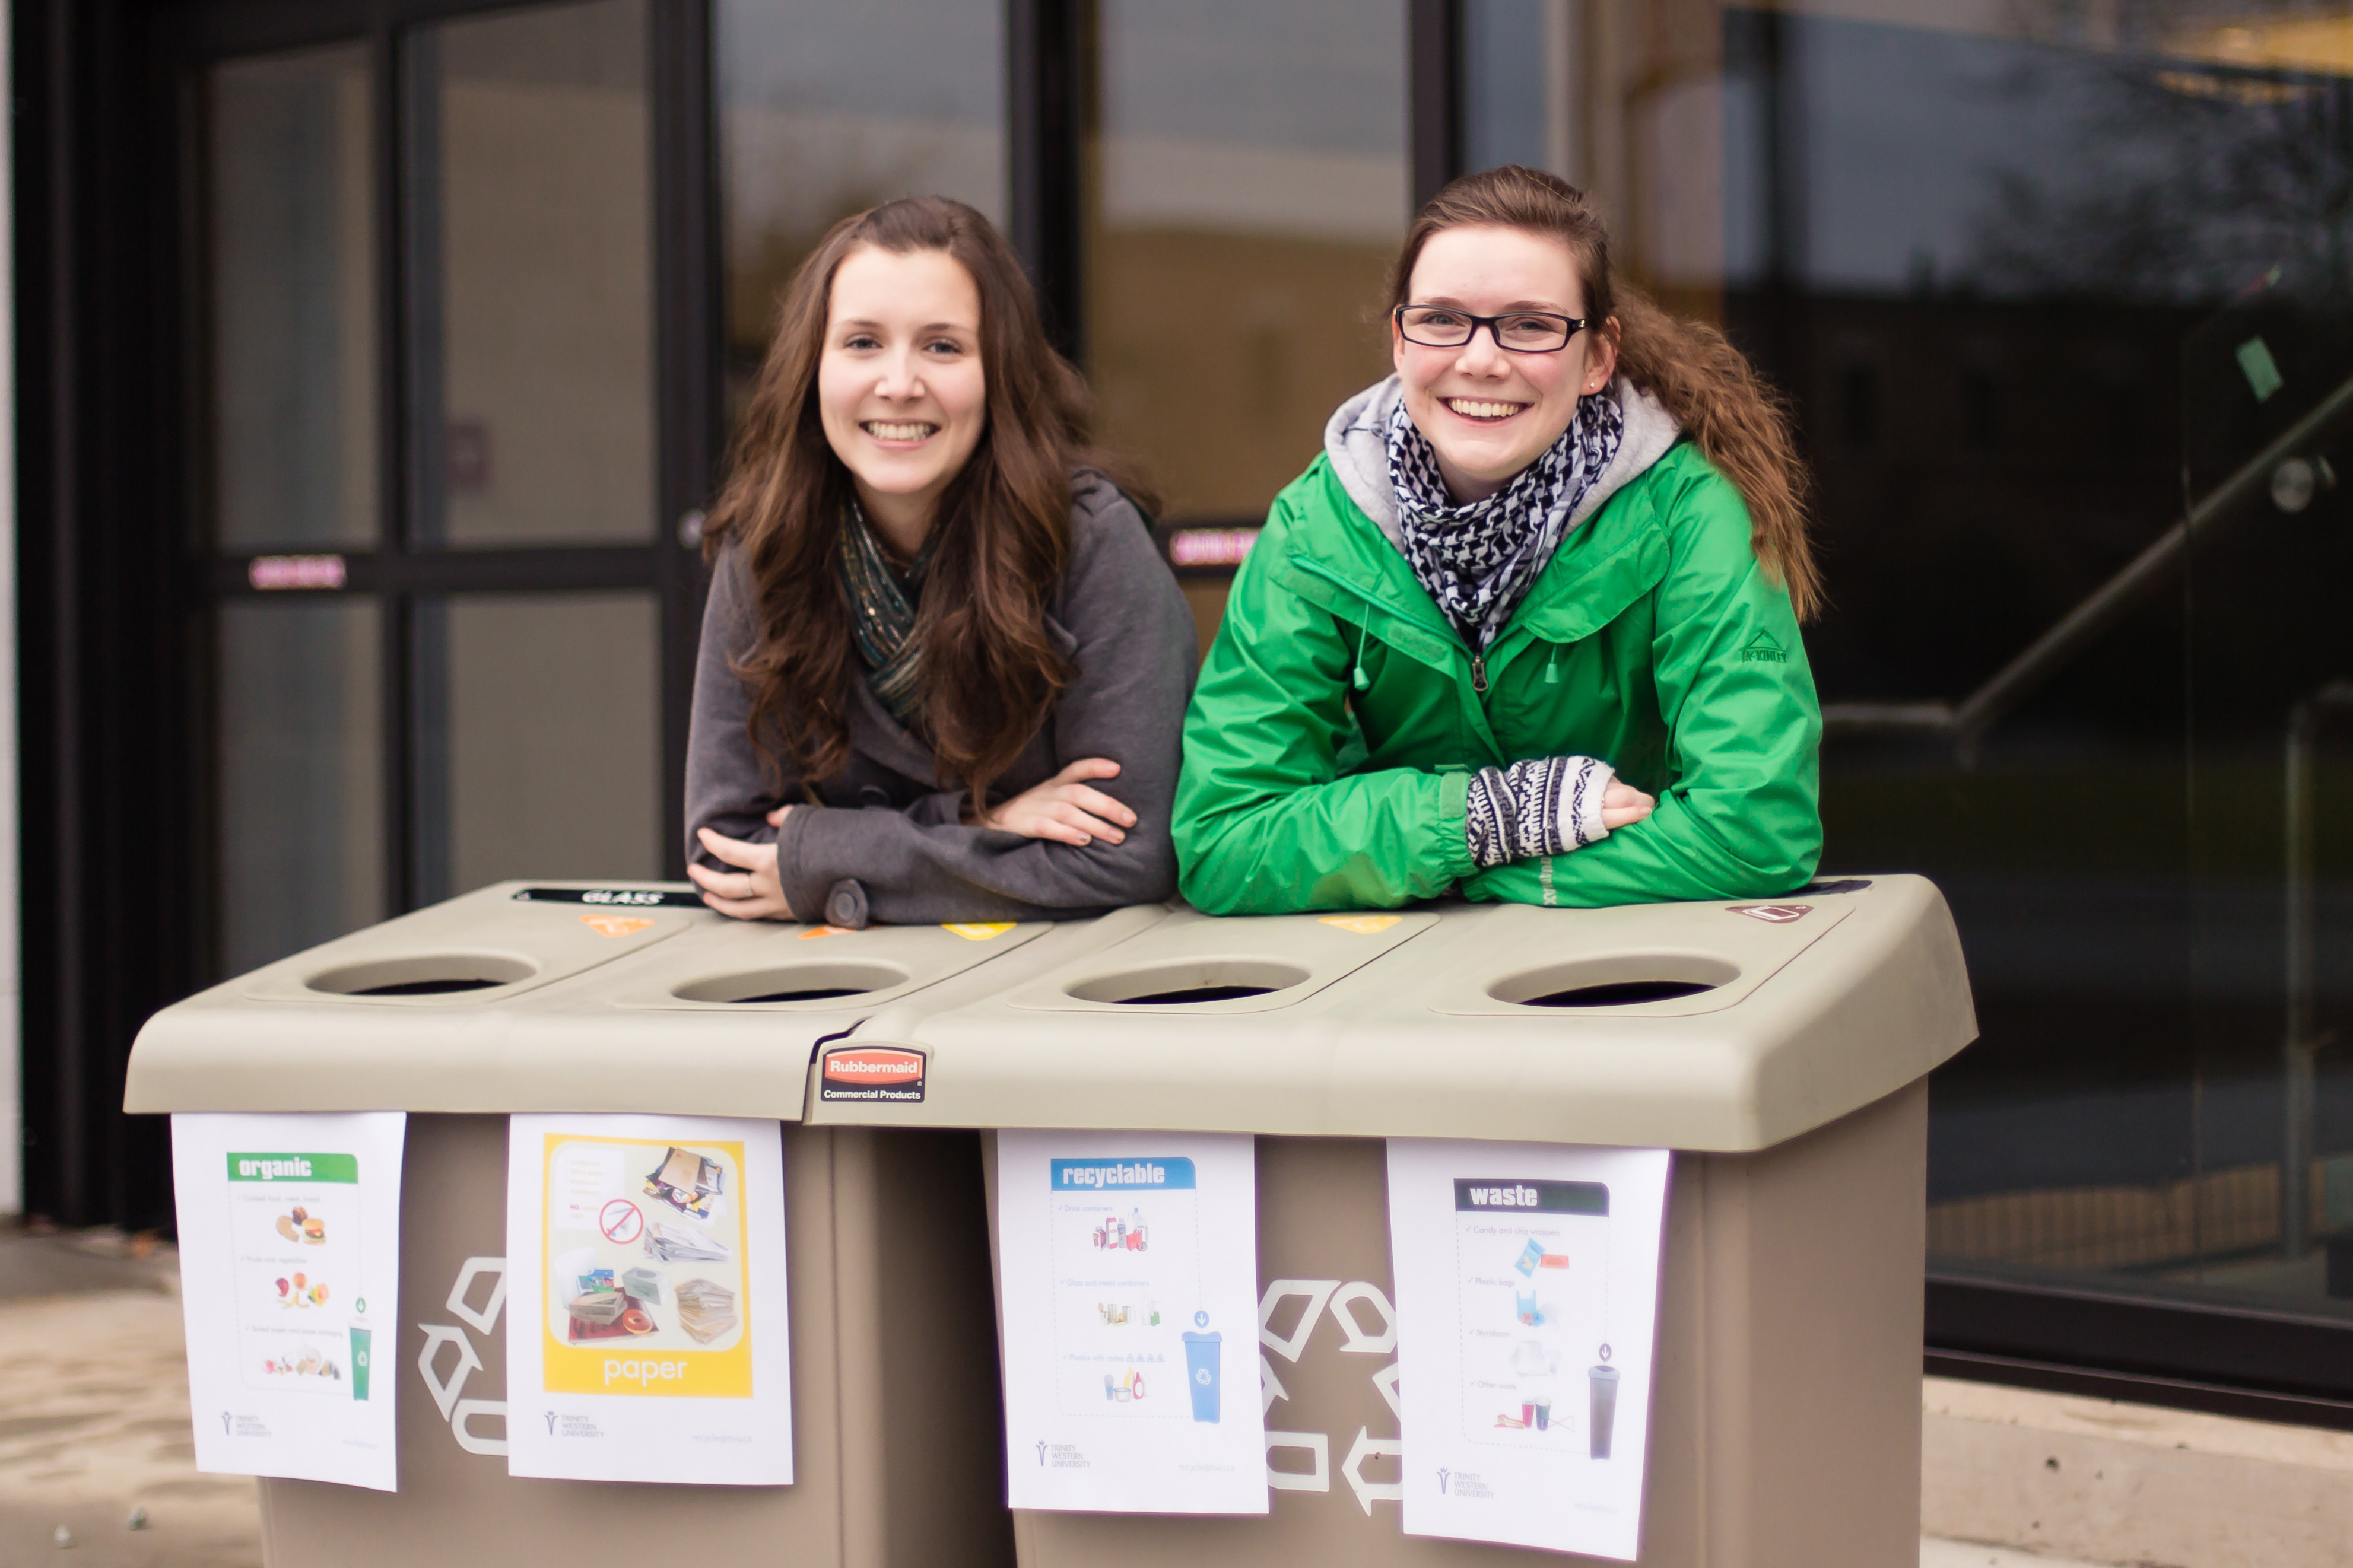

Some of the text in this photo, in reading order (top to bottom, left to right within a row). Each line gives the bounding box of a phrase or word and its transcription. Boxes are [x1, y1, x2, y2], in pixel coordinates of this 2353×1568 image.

[582, 890, 665, 905] GLASS
[831, 1060, 917, 1073] Rubbermaid
[824, 1089, 921, 1099] Commercial Products
[239, 1156, 312, 1180] organic
[1063, 1163, 1165, 1188] recyclable
[1469, 1185, 1538, 1206] waste
[1473, 1226, 1497, 1235] Candy
[1514, 1227, 1529, 1236] chip
[1066, 1278, 1084, 1287] Glass
[1475, 1277, 1515, 1288] Plastic bags
[1476, 1329, 1511, 1338] Styrofoam
[1069, 1353, 1091, 1362] Plastics
[604, 1359, 688, 1387] paper
[1478, 1381, 1497, 1389] Other
[561, 1414, 589, 1423] TRINITY
[1050, 1444, 1076, 1452] TRINITY
[1052, 1460, 1091, 1468] UNIVERSITY
[1454, 1472, 1481, 1481] TRINITY
[1454, 1481, 1488, 1490] WESTERN
[1454, 1489, 1495, 1499] UNIVERSITY
